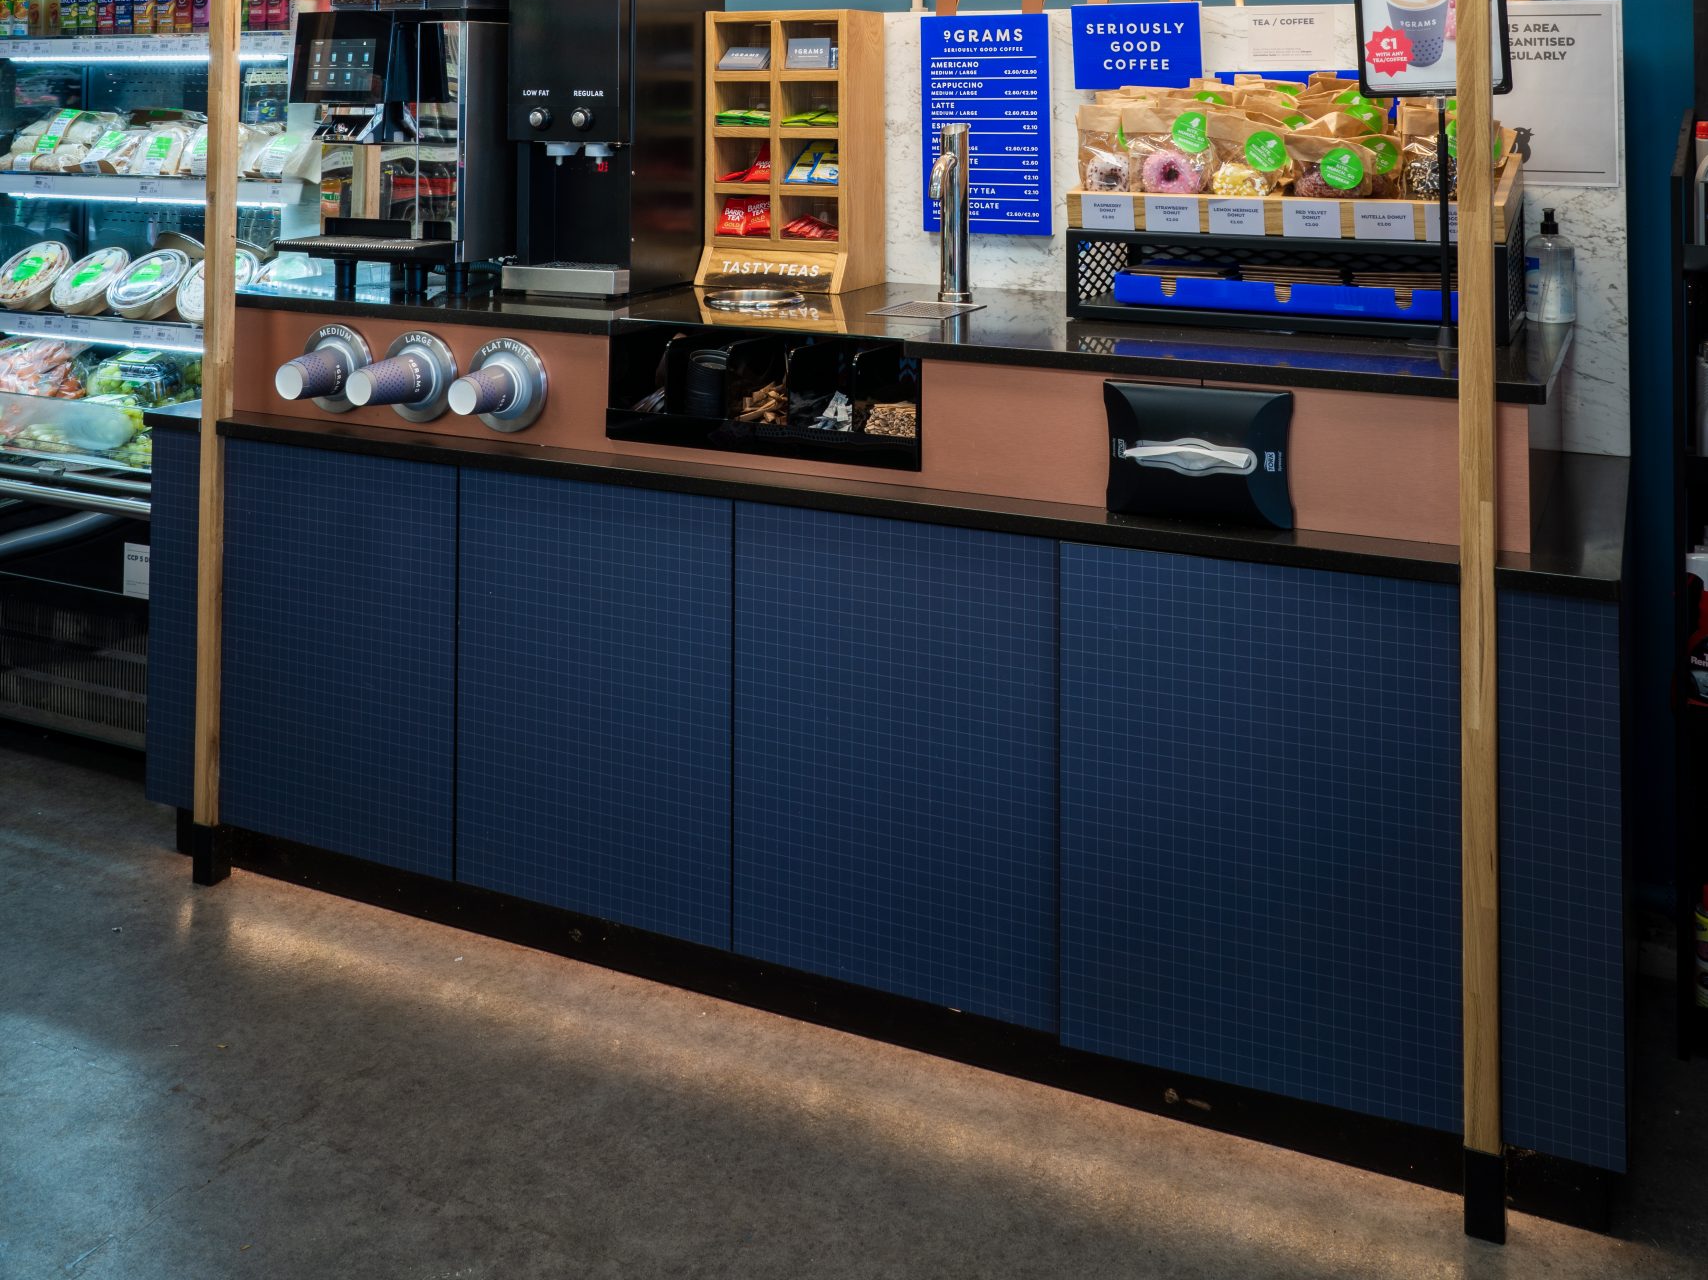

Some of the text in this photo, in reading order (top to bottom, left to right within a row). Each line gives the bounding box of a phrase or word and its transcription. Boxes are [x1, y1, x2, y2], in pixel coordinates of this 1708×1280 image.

[1252, 18, 1270, 26] TEA
[1279, 17, 1315, 25] COFFEE
[1085, 22, 1185, 35] SERIOUSLY
[1508, 23, 1560, 33] IS AREA
[1110, 40, 1161, 53] GOOD
[1380, 37, 1398, 50] €1
[1508, 37, 1576, 47] SANITISED
[1509, 51, 1567, 60] GULARLY
[930, 61, 979, 69] AMERICANO
[1103, 58, 1170, 70] COFFEE
[931, 81, 984, 89] CAPPUCCINO
[980, 187, 996, 195] TEA
[969, 202, 1000, 210] COLATE
[722, 260, 820, 277] TASTY TEAS
[319, 327, 352, 341] MEDIUM
[405, 334, 432, 346] LARGE
[481, 340, 531, 361] FLAT WHITE
